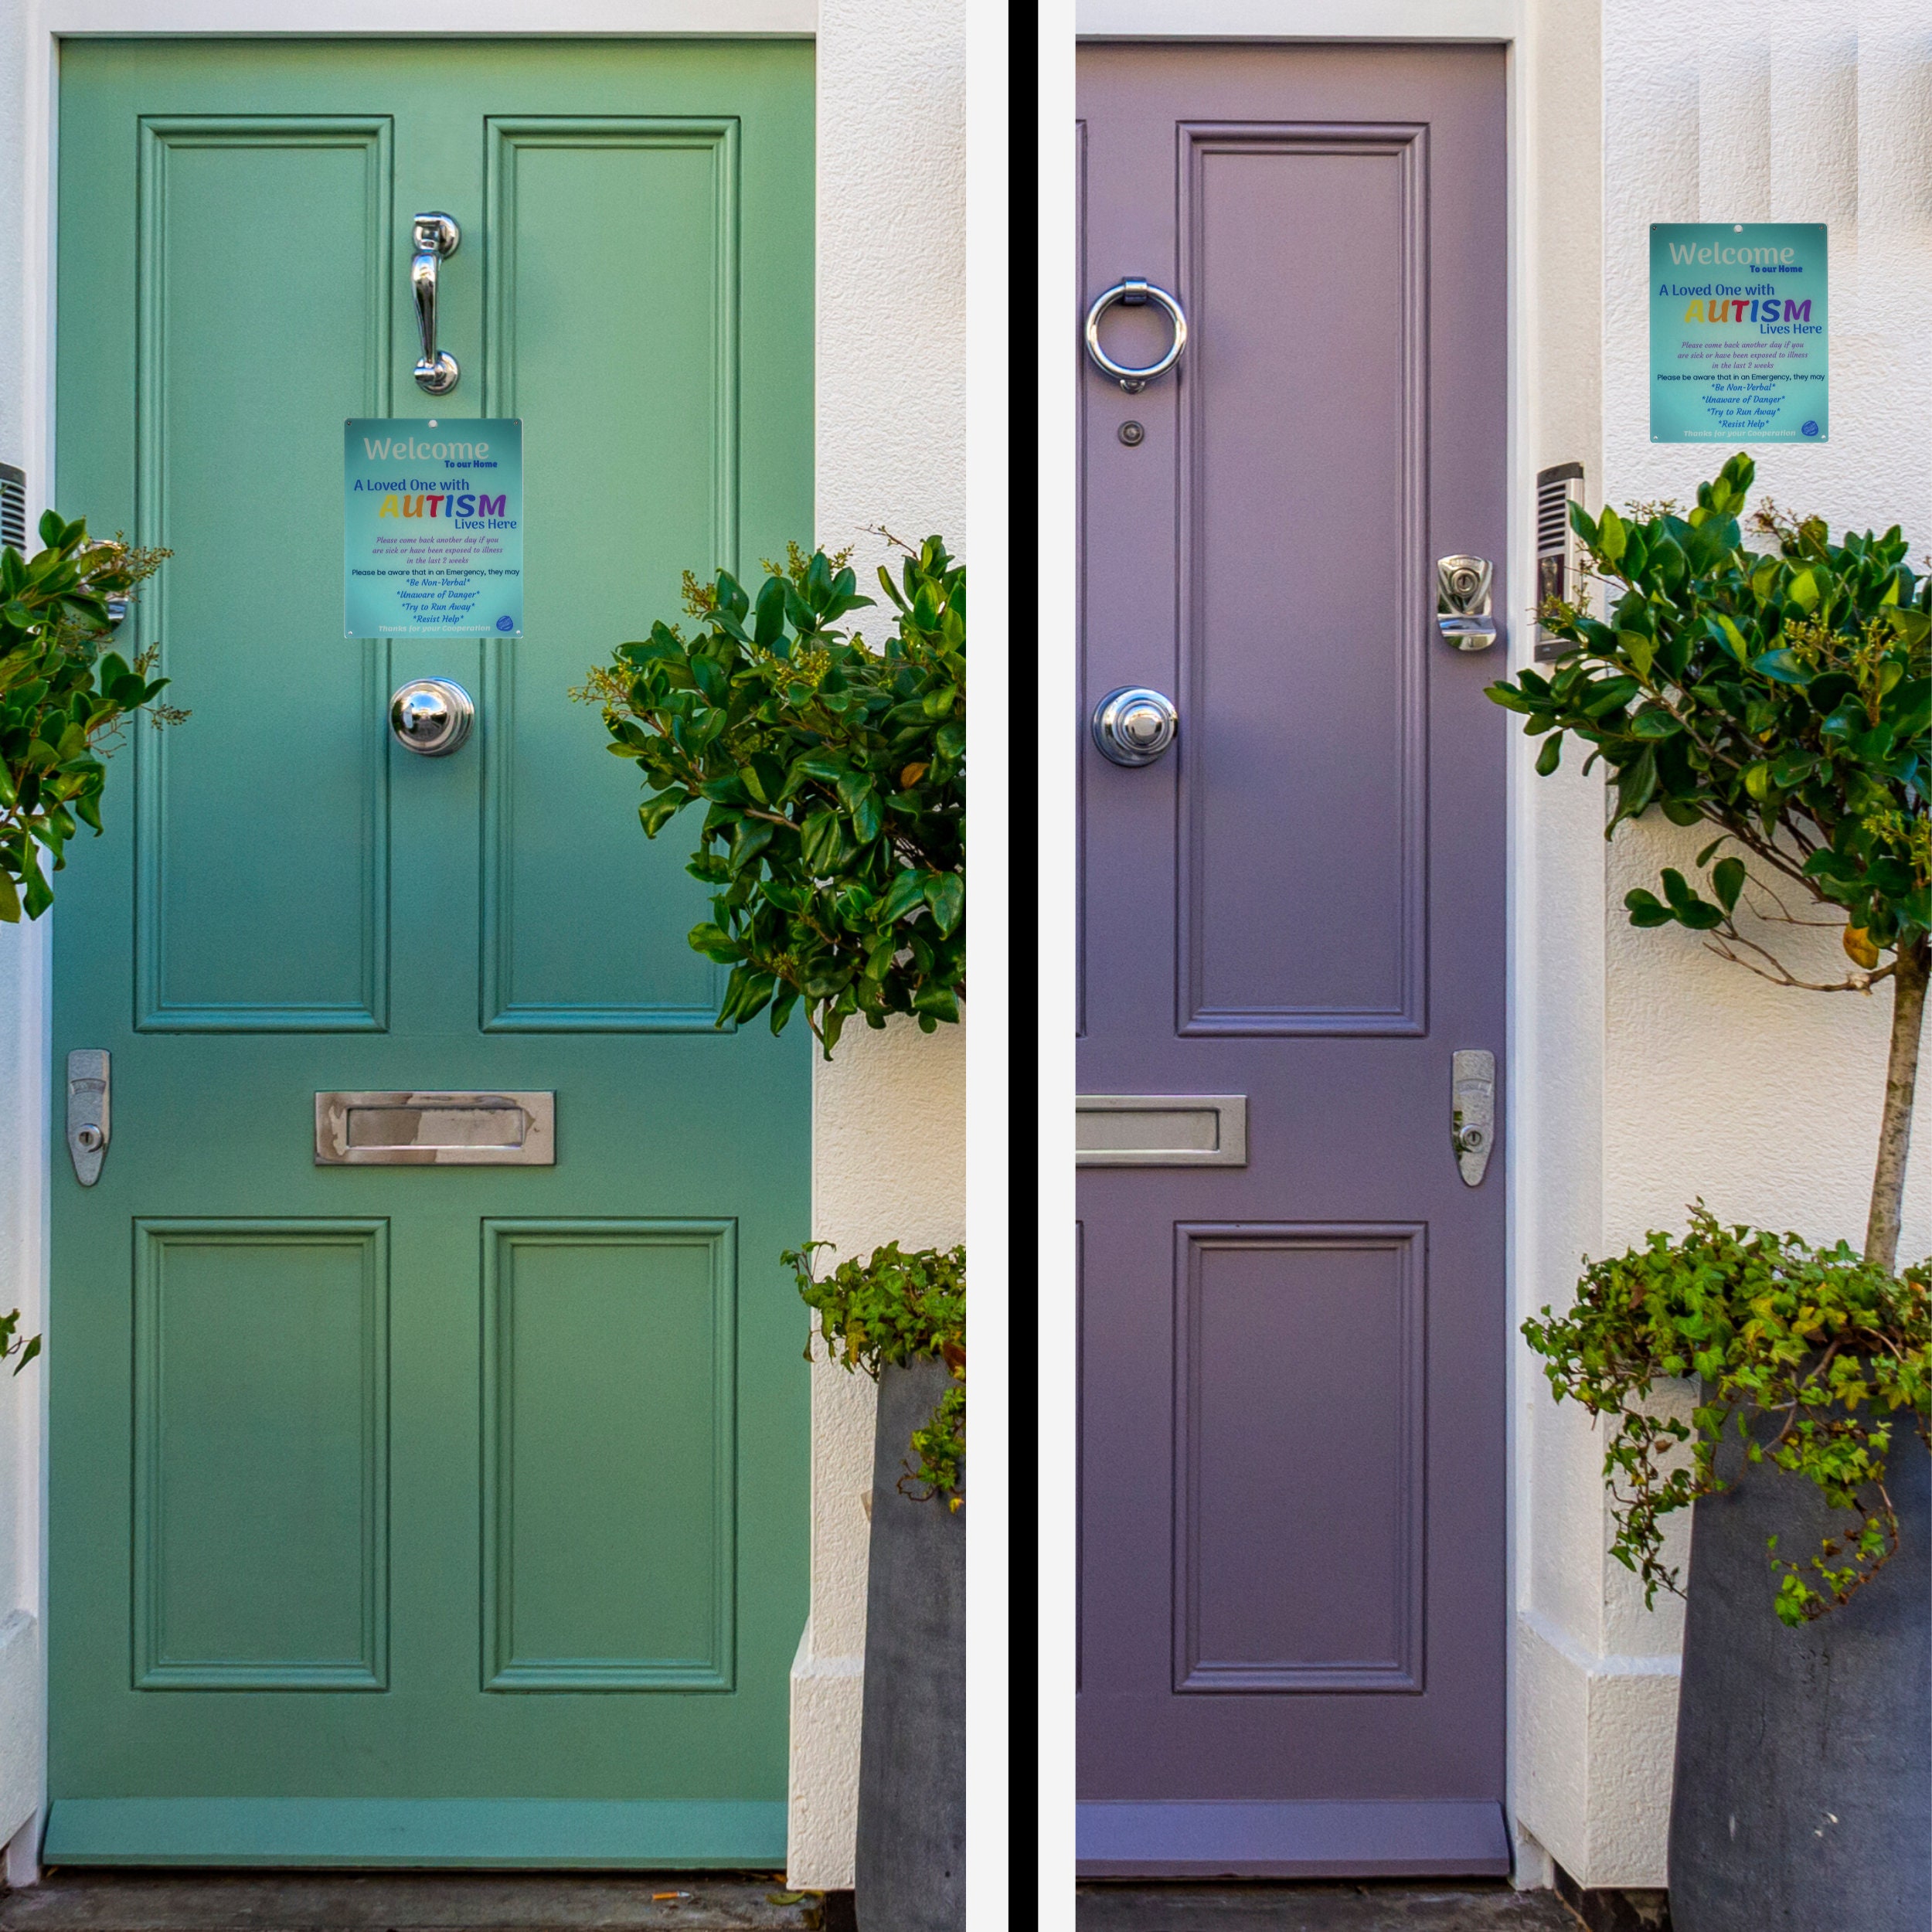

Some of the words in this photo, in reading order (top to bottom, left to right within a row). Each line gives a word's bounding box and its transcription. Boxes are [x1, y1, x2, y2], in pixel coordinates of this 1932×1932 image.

[1669, 242, 1794, 265] Welcome
[1659, 284, 1669, 296] A
[1673, 284, 1712, 296] Loved
[1716, 284, 1741, 296] One
[1745, 284, 1774, 296] with
[1684, 299, 1812, 323] AUTISM
[1760, 324, 1790, 334] Lives
[1793, 324, 1822, 334] Here
[1770, 342, 1782, 350] day
[1784, 342, 1790, 350] if
[1750, 352, 1777, 360] exposed
[1742, 396, 1752, 405] of
[364, 437, 489, 460] Welcome
[354, 480, 363, 491] A
[367, 479, 406, 491] Loved
[410, 479, 436, 491] One
[439, 479, 469, 491] with
[379, 494, 506, 518] AUTISM
[455, 520, 485, 529] Lives
[488, 520, 516, 529] Here
[465, 537, 477, 545] day
[479, 537, 485, 545] if
[445, 547, 472, 555] exposed
[488, 569, 504, 577] they
[437, 591, 446, 600] of
